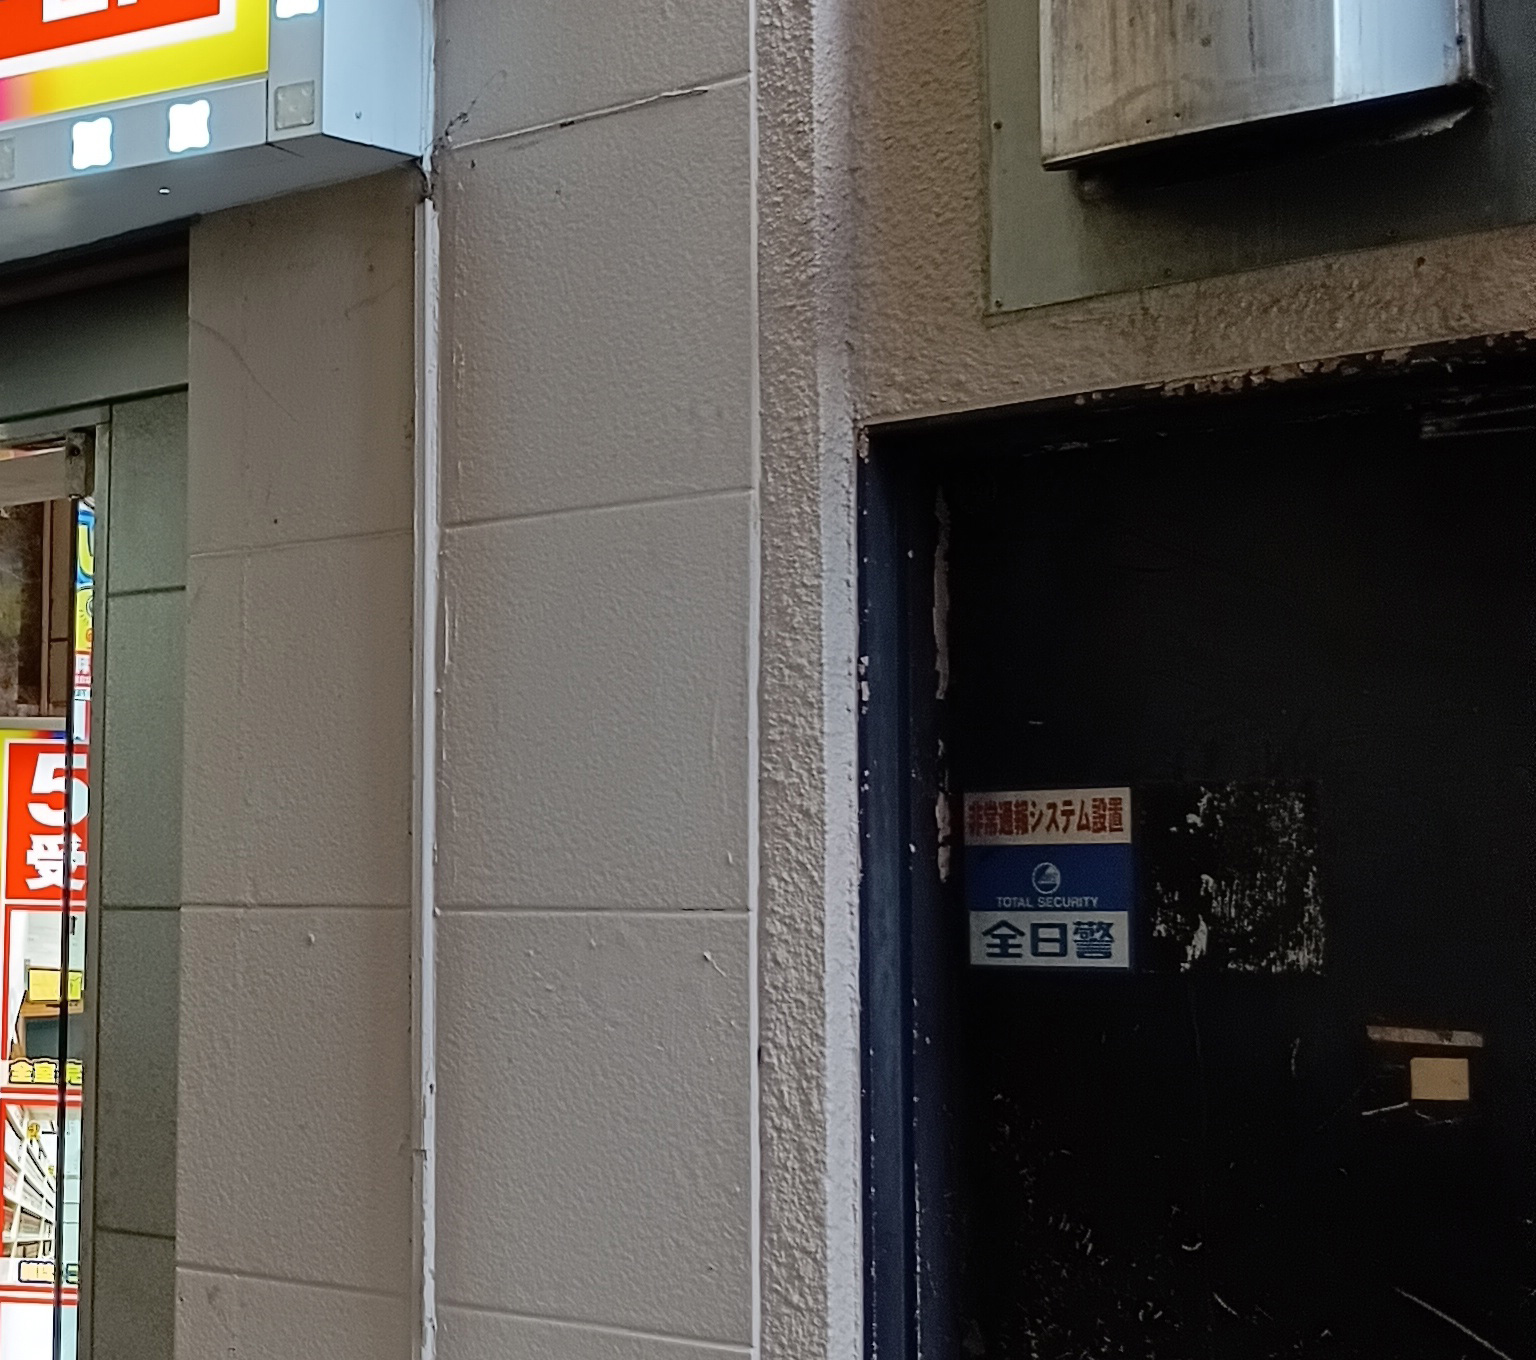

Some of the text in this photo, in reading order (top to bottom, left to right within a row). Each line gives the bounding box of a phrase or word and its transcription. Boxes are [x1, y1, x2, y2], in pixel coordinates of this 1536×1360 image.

[969, 797, 1124, 836] 非常通報システム設置
[997, 896, 1099, 908] TOTAL SECURITY
[982, 919, 1115, 959] 全日警
